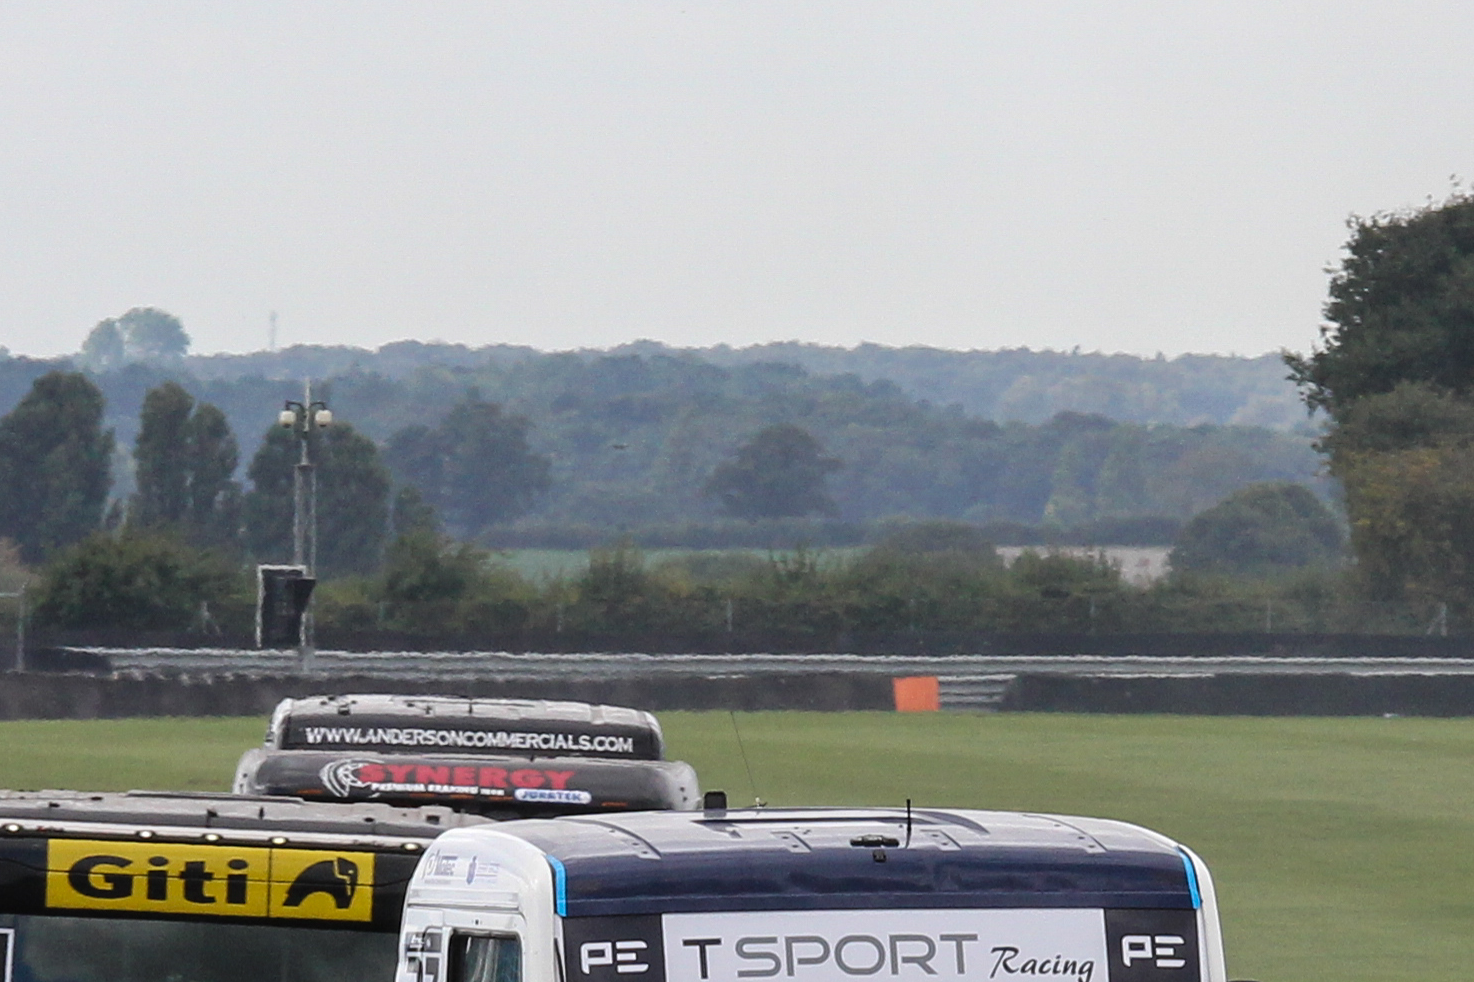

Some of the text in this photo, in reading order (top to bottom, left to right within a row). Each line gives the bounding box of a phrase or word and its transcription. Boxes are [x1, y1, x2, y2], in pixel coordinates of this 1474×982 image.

[305, 727, 634, 753] WWW.ANDERSONCOMMERCIALS.COM
[357, 764, 576, 790] SYNERGY
[68, 855, 249, 905] Giti
